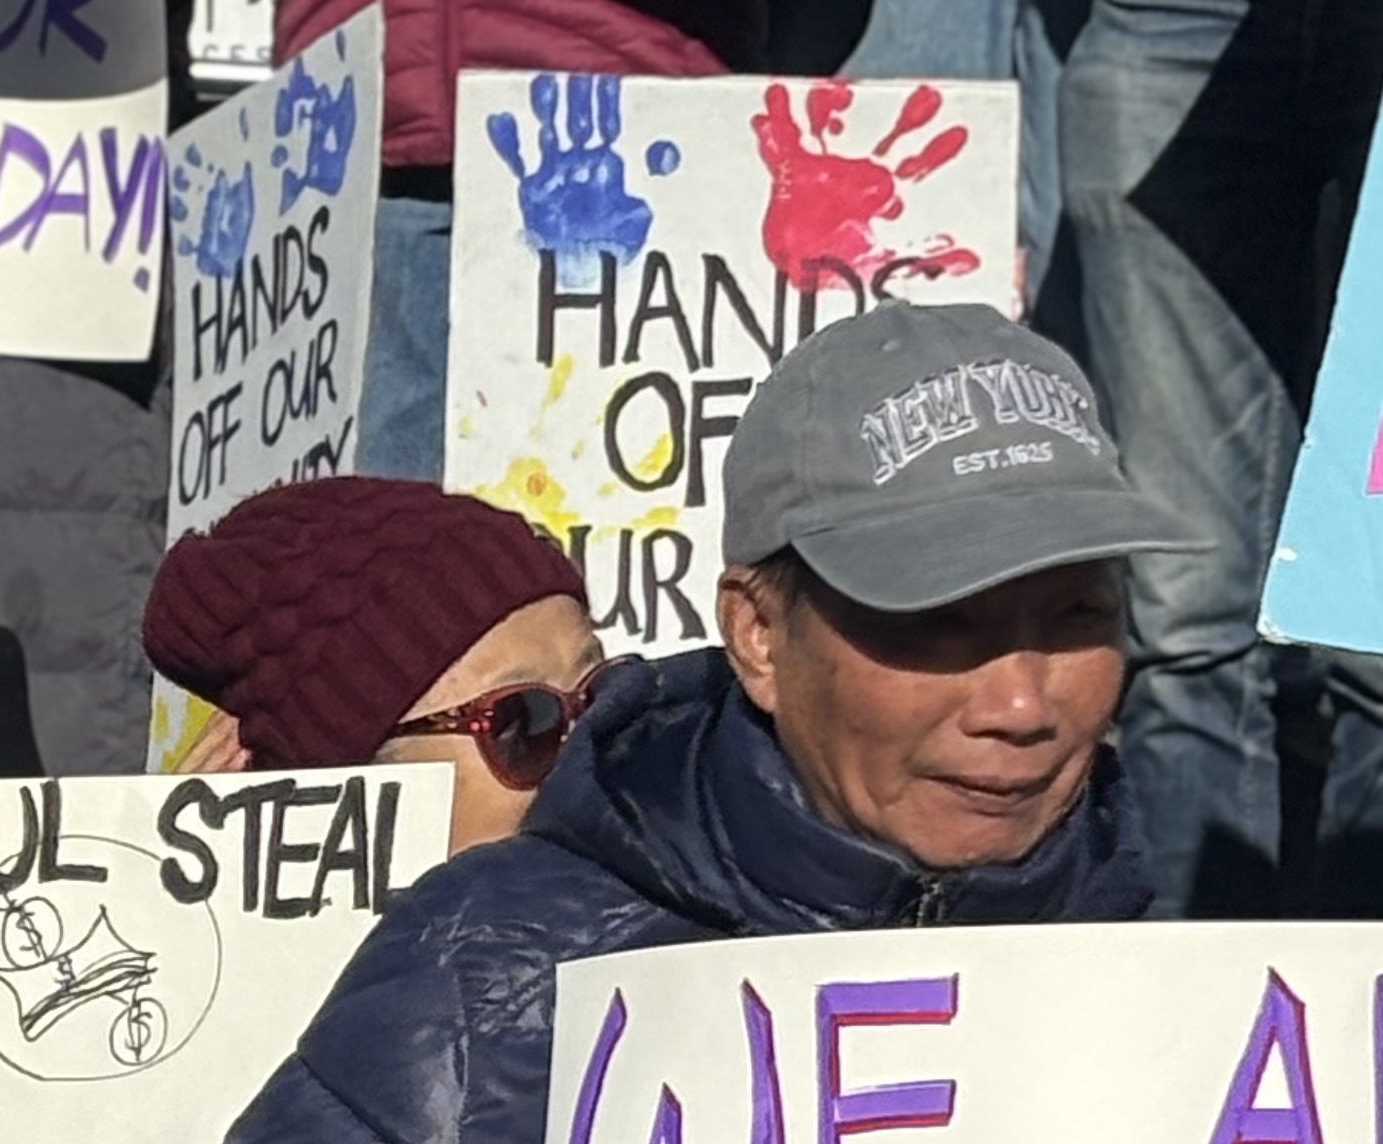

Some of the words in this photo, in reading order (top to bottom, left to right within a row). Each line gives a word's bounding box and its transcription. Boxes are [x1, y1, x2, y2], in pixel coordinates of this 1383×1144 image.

[191, 205, 331, 382] HANDS
[178, 384, 244, 505] OFF
[260, 319, 340, 448] OUR
[603, 371, 754, 508] OF
[860, 363, 978, 486] NEW
[532, 521, 709, 645] UR
[156, 776, 418, 920] STEAL
